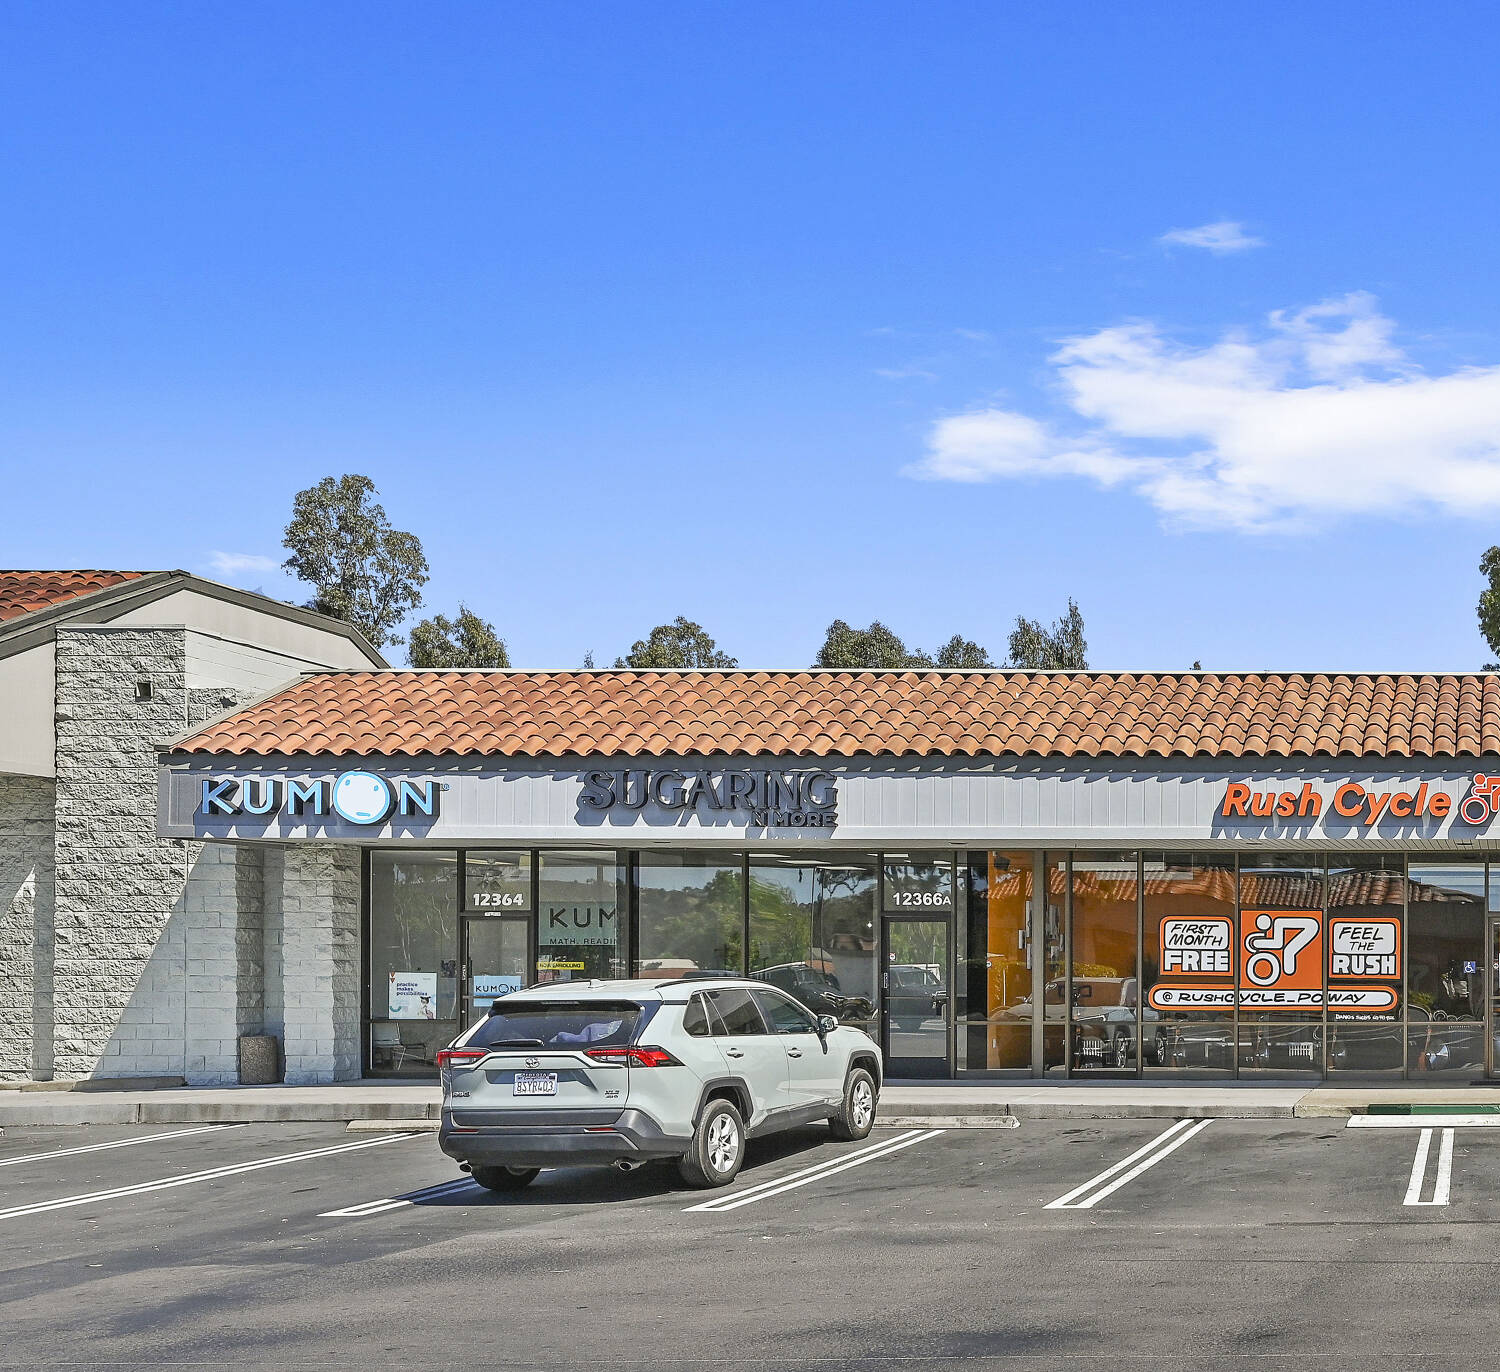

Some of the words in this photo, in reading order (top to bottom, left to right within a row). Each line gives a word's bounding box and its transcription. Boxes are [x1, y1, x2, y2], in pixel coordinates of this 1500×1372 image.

[582, 770, 838, 809] SUGARING
[201, 770, 434, 825] KUMON
[1222, 783, 1322, 816] Rush
[1333, 783, 1452, 825] Cycle
[772, 812, 838, 827] MORE
[473, 893, 524, 906] 12364
[1171, 924, 1218, 934] FIRST
[1338, 927, 1384, 940] FEEL
[1168, 934, 1223, 946] MONTH
[1349, 941, 1375, 951] THE
[1164, 950, 1229, 972] FREE
[1331, 954, 1396, 975] RUSH
[475, 983, 517, 993] KUMON
